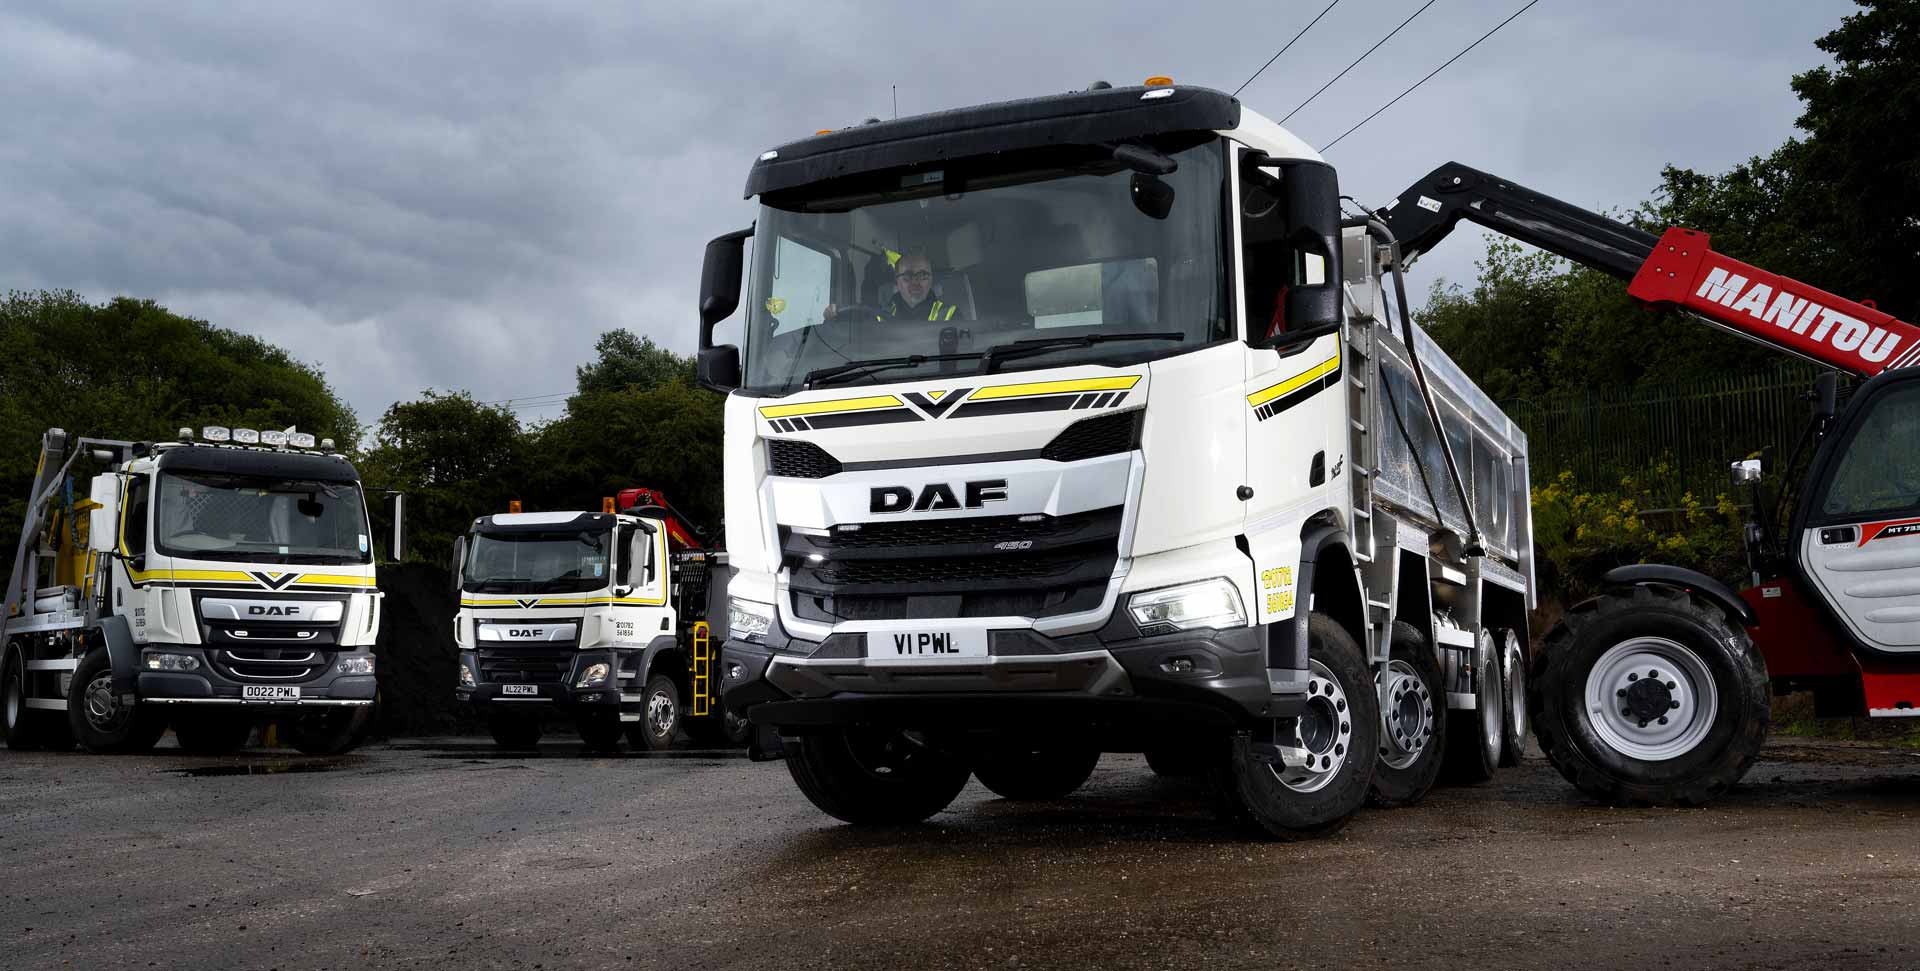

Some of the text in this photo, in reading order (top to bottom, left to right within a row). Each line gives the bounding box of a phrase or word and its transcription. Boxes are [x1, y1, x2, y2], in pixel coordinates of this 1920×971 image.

[1695, 266, 1903, 363] MANITOU
[869, 478, 1009, 514] DAF
[994, 540, 1033, 550] 450
[248, 605, 300, 616] DAF
[509, 629, 544, 637] DAF
[918, 632, 960, 654] PWL
[276, 687, 297, 697] PWL
